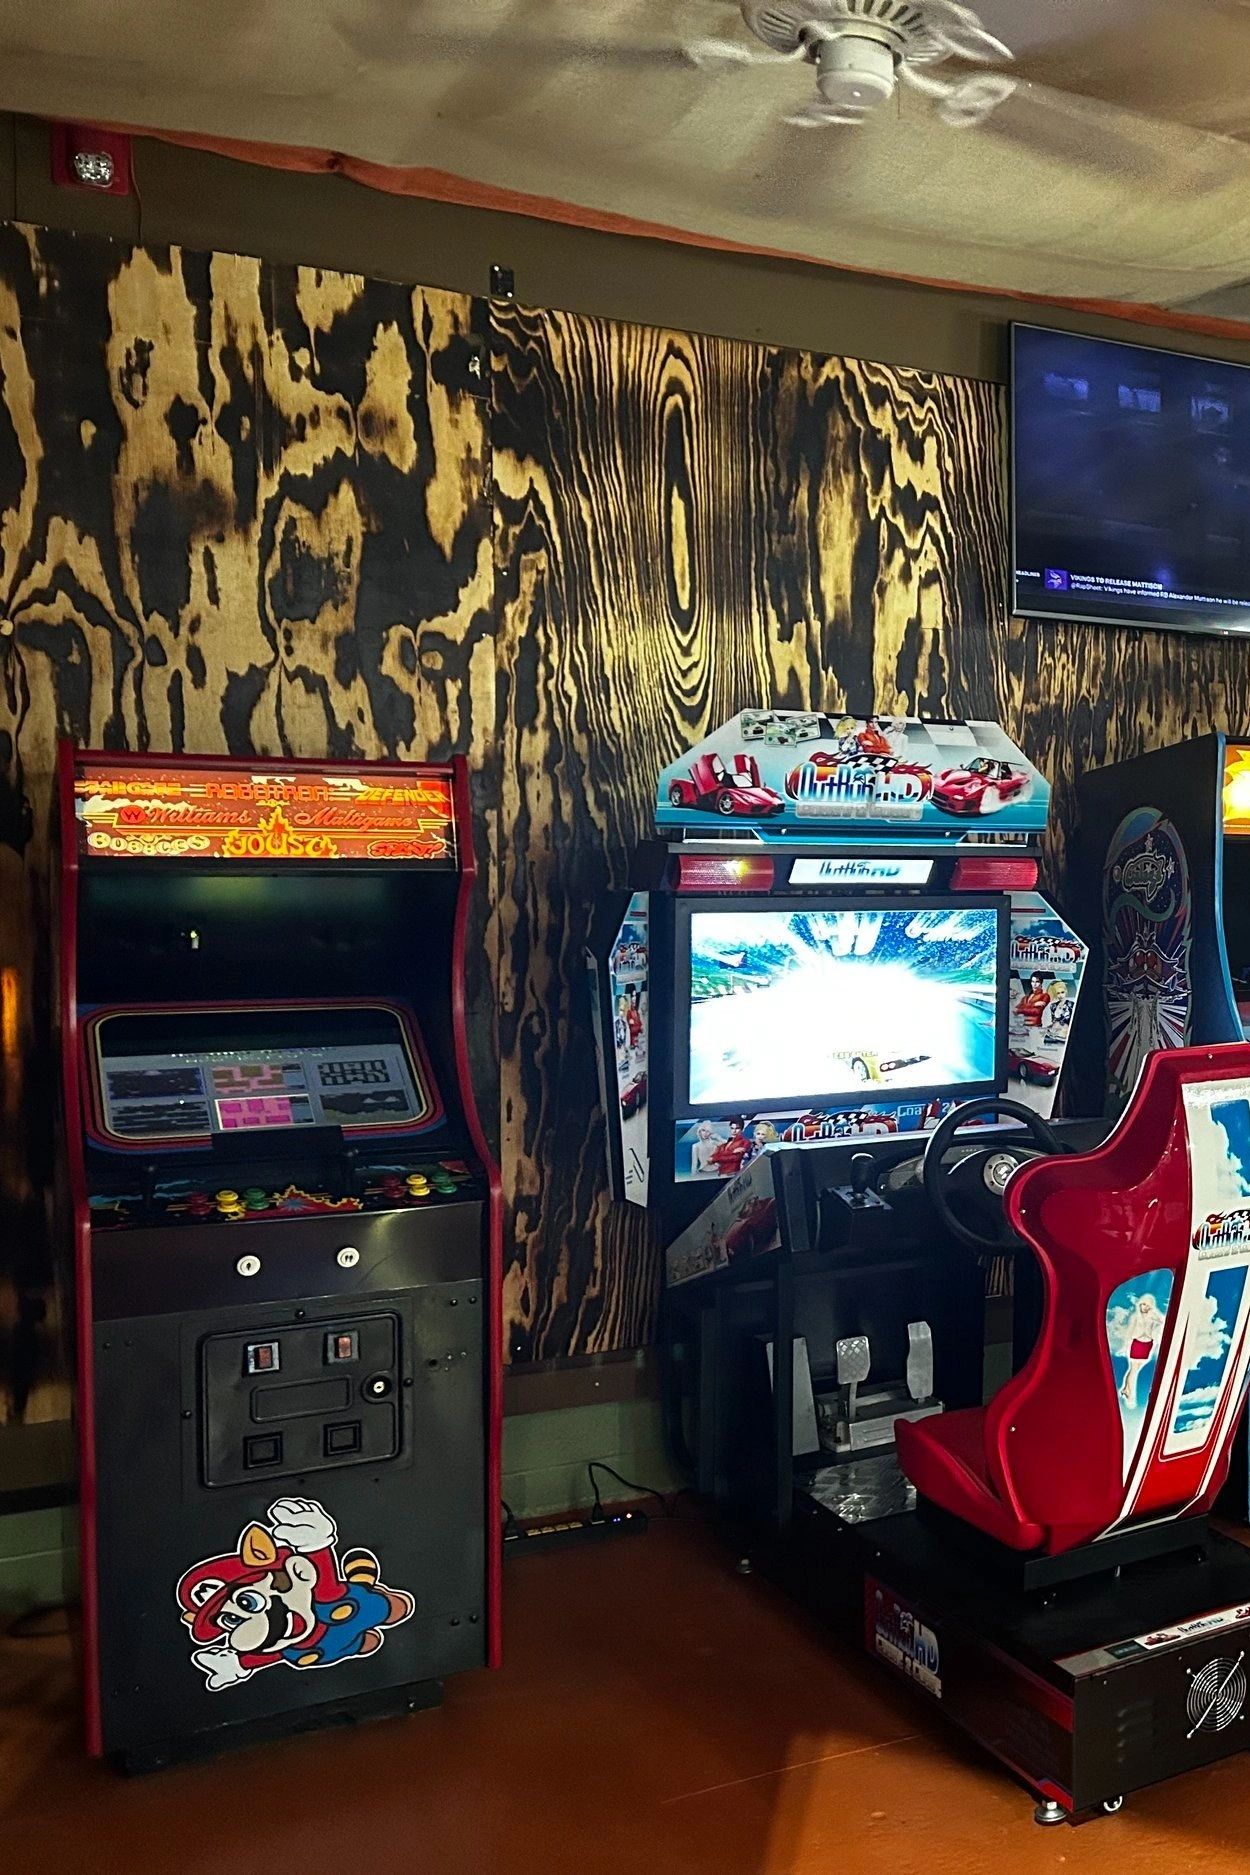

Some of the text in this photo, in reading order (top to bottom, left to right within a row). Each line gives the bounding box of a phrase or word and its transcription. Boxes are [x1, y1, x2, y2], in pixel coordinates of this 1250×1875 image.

[1070, 574, 1095, 583] VIKINGS
[1105, 578, 1131, 587] RELEASE
[1132, 581, 1162, 590] MATTISON
[356, 787, 449, 806] DEFENDER
[876, 773, 923, 803] HD
[147, 804, 252, 825] Williams
[88, 832, 211, 855] BUBBLES
[226, 829, 339, 859] JOUST
